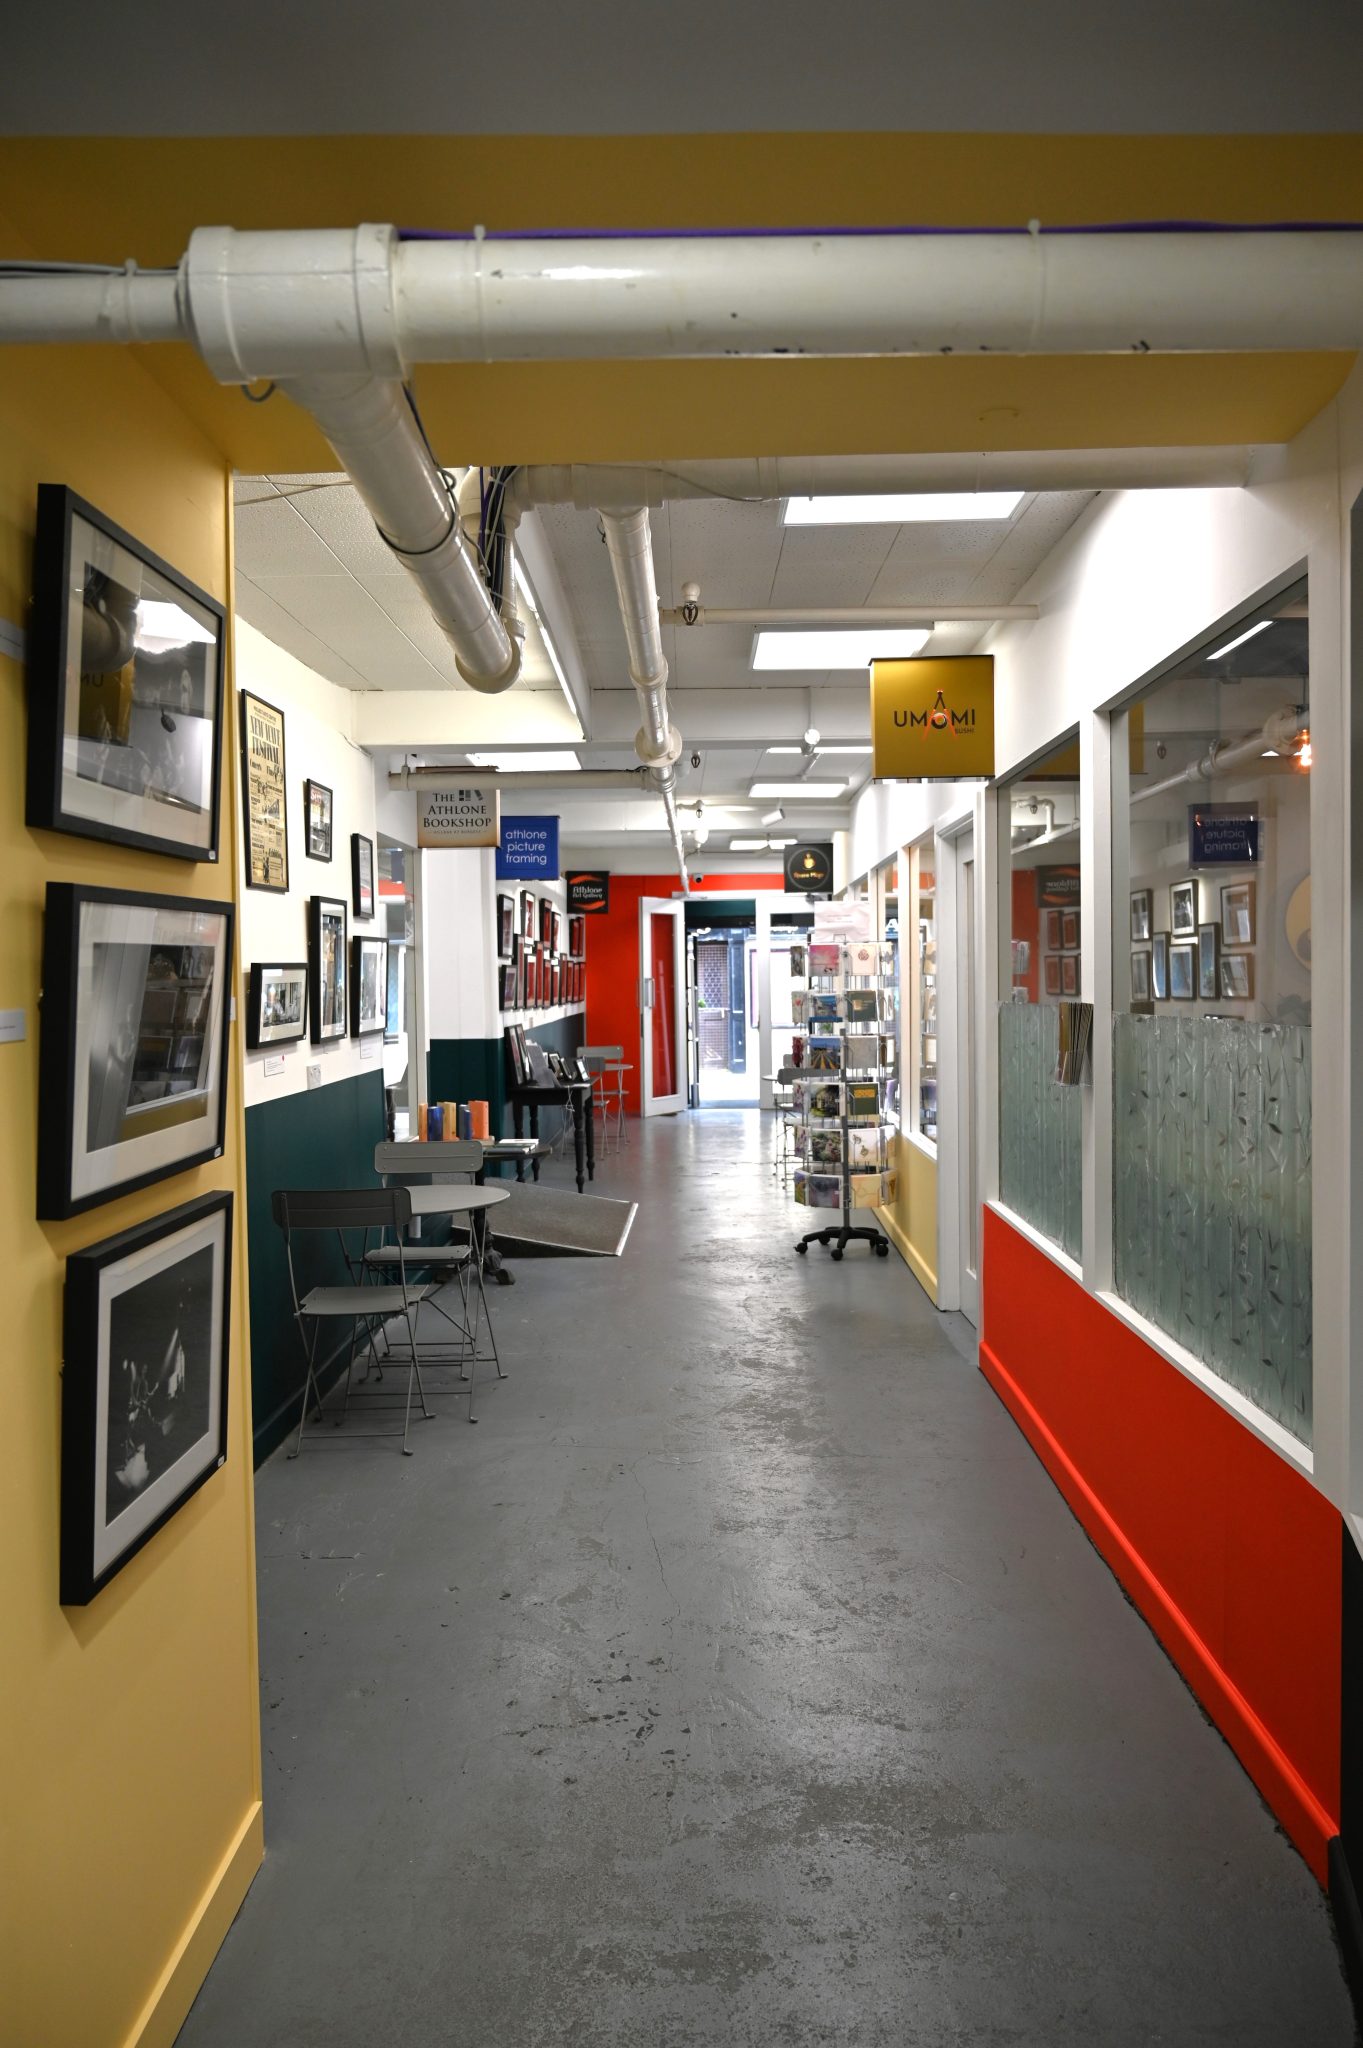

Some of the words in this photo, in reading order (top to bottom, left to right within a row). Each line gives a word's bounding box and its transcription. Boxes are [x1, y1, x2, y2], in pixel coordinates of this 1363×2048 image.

[893, 692, 976, 728] UMAMI
[432, 792, 455, 802] THE
[428, 805, 487, 815] ATHLONE
[423, 818, 492, 828] BOOKSHOP
[505, 829, 547, 839] athlone
[507, 841, 545, 853] picture
[506, 854, 547, 866] framing
